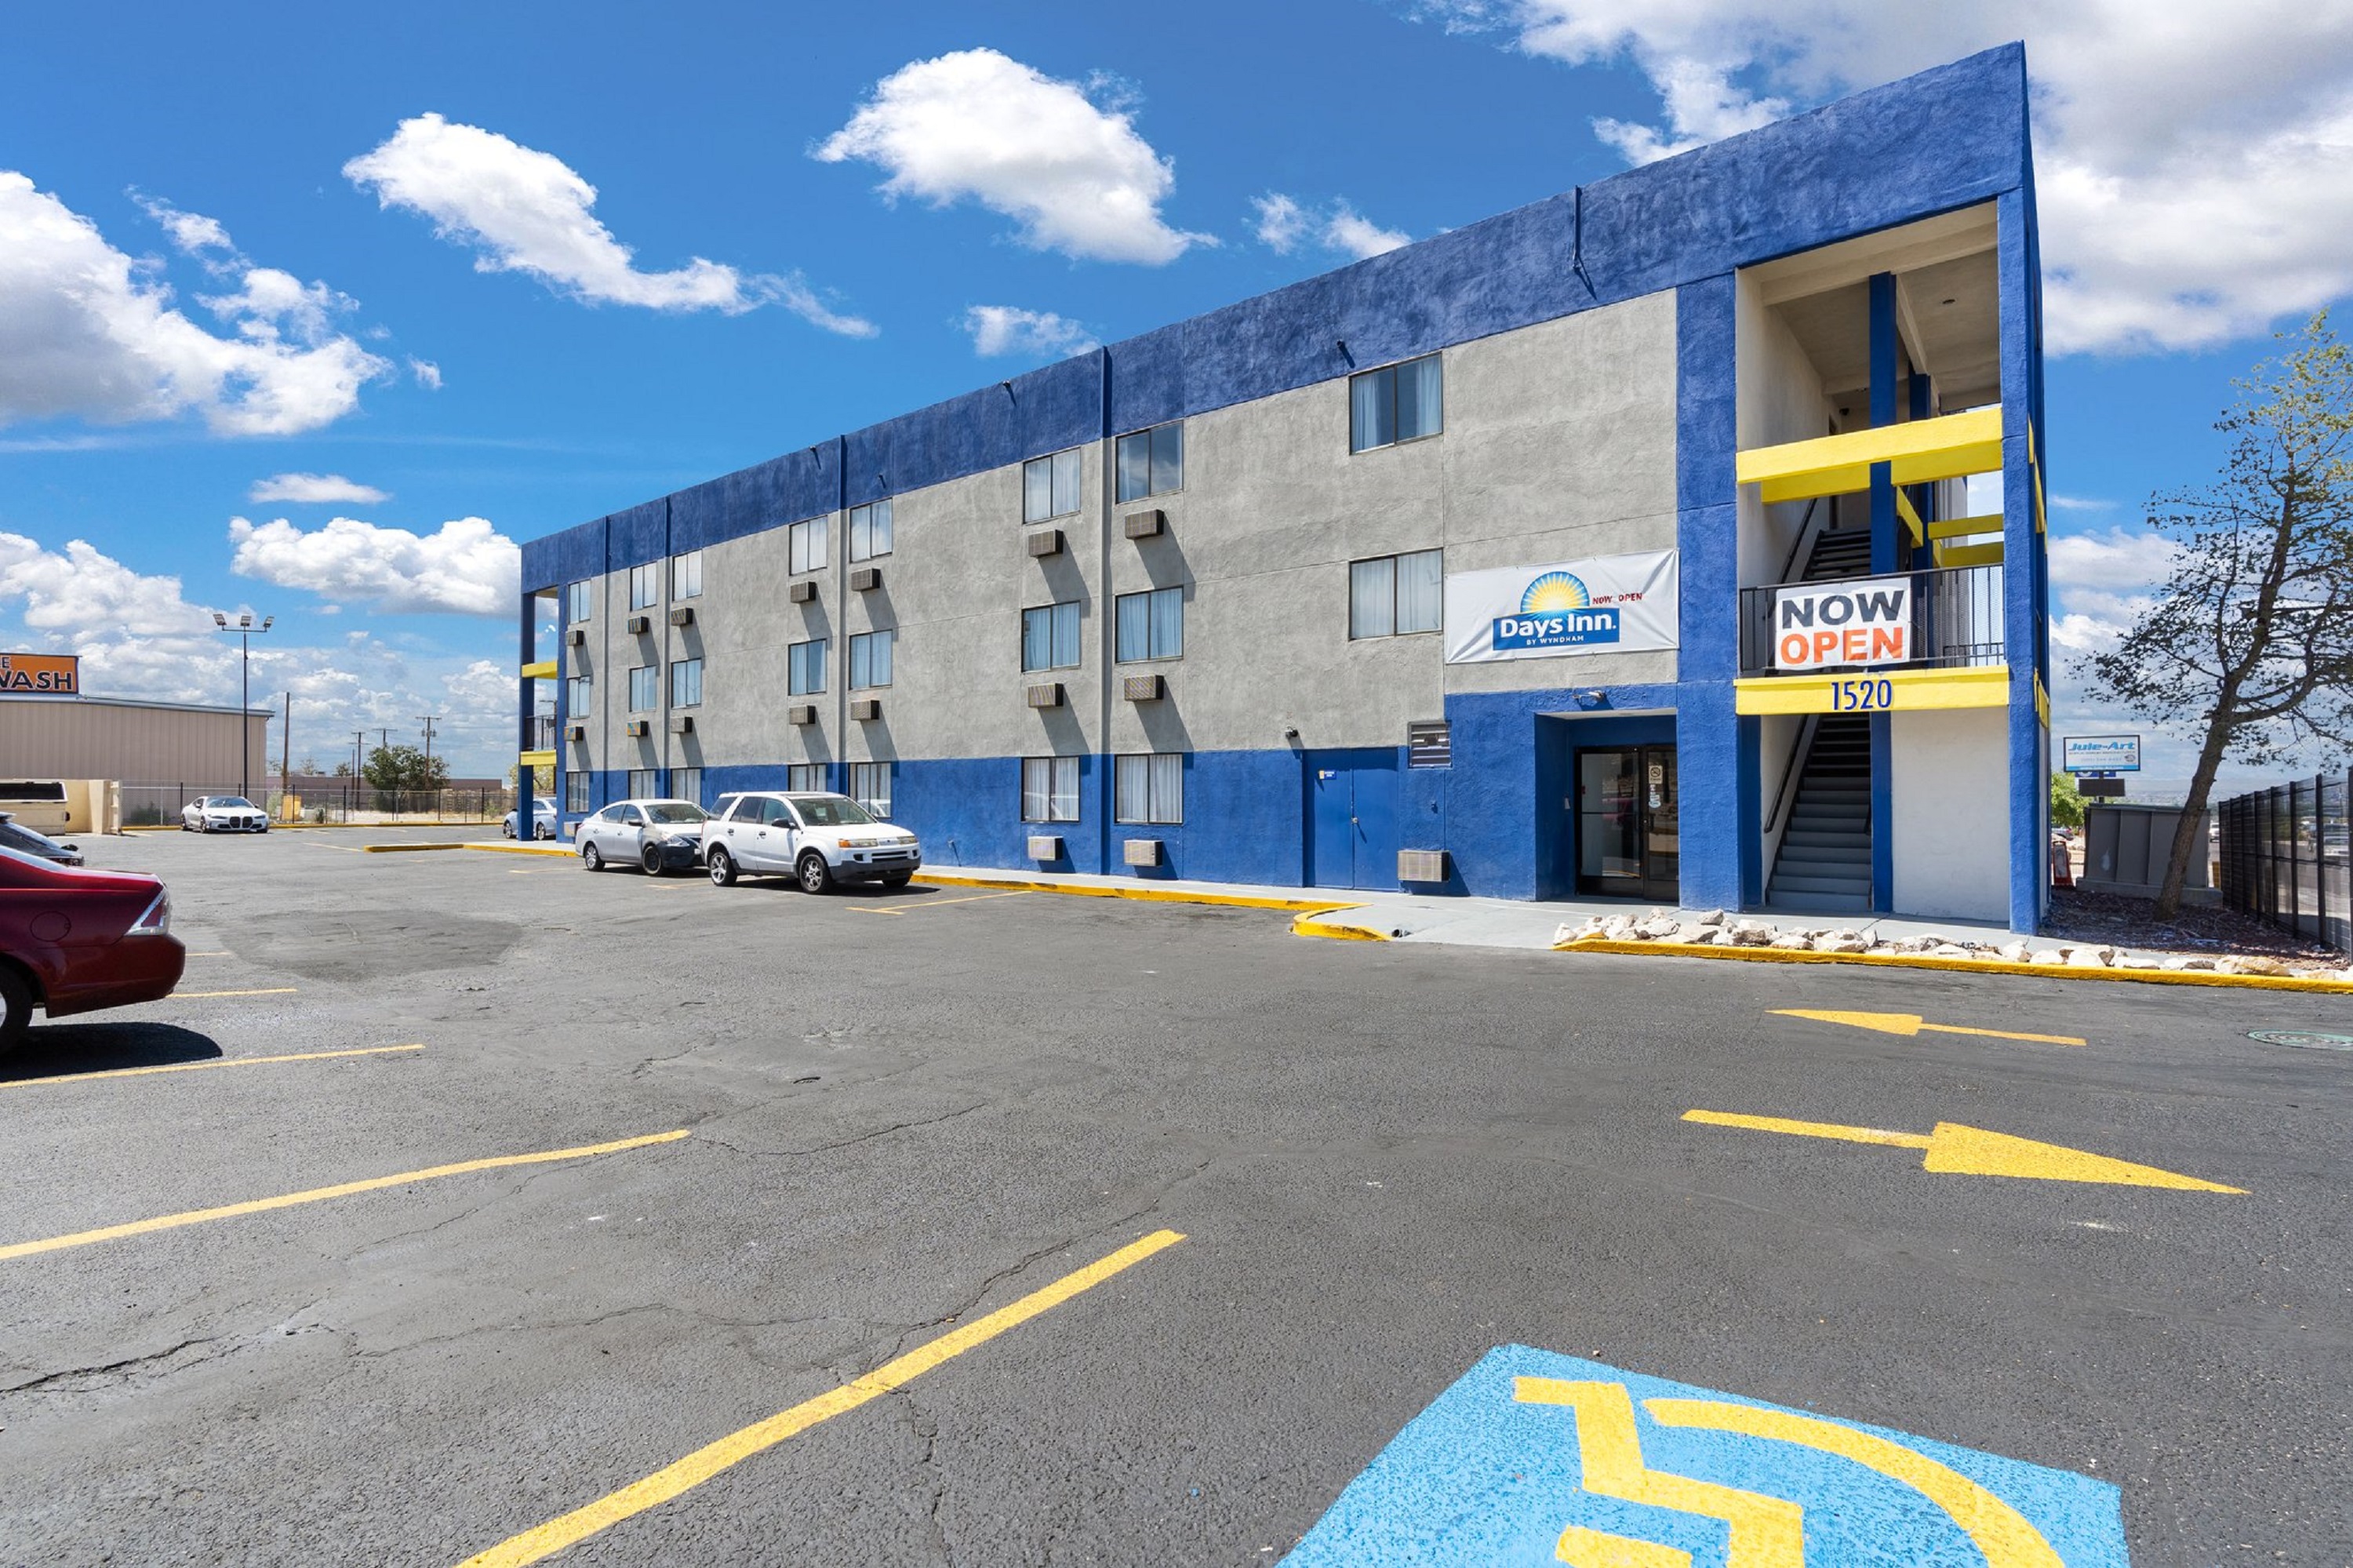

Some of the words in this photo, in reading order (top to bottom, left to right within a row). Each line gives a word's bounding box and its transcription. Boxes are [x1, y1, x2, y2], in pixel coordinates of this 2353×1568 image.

[1592, 596, 1613, 605] NOW
[1618, 593, 1642, 602] OPEN
[1781, 591, 1904, 629] NOW
[1500, 618, 1563, 638] Days
[1540, 635, 1584, 645] WYNDHAM
[1780, 628, 1903, 664] OPEN
[1831, 679, 1893, 711] 1520
